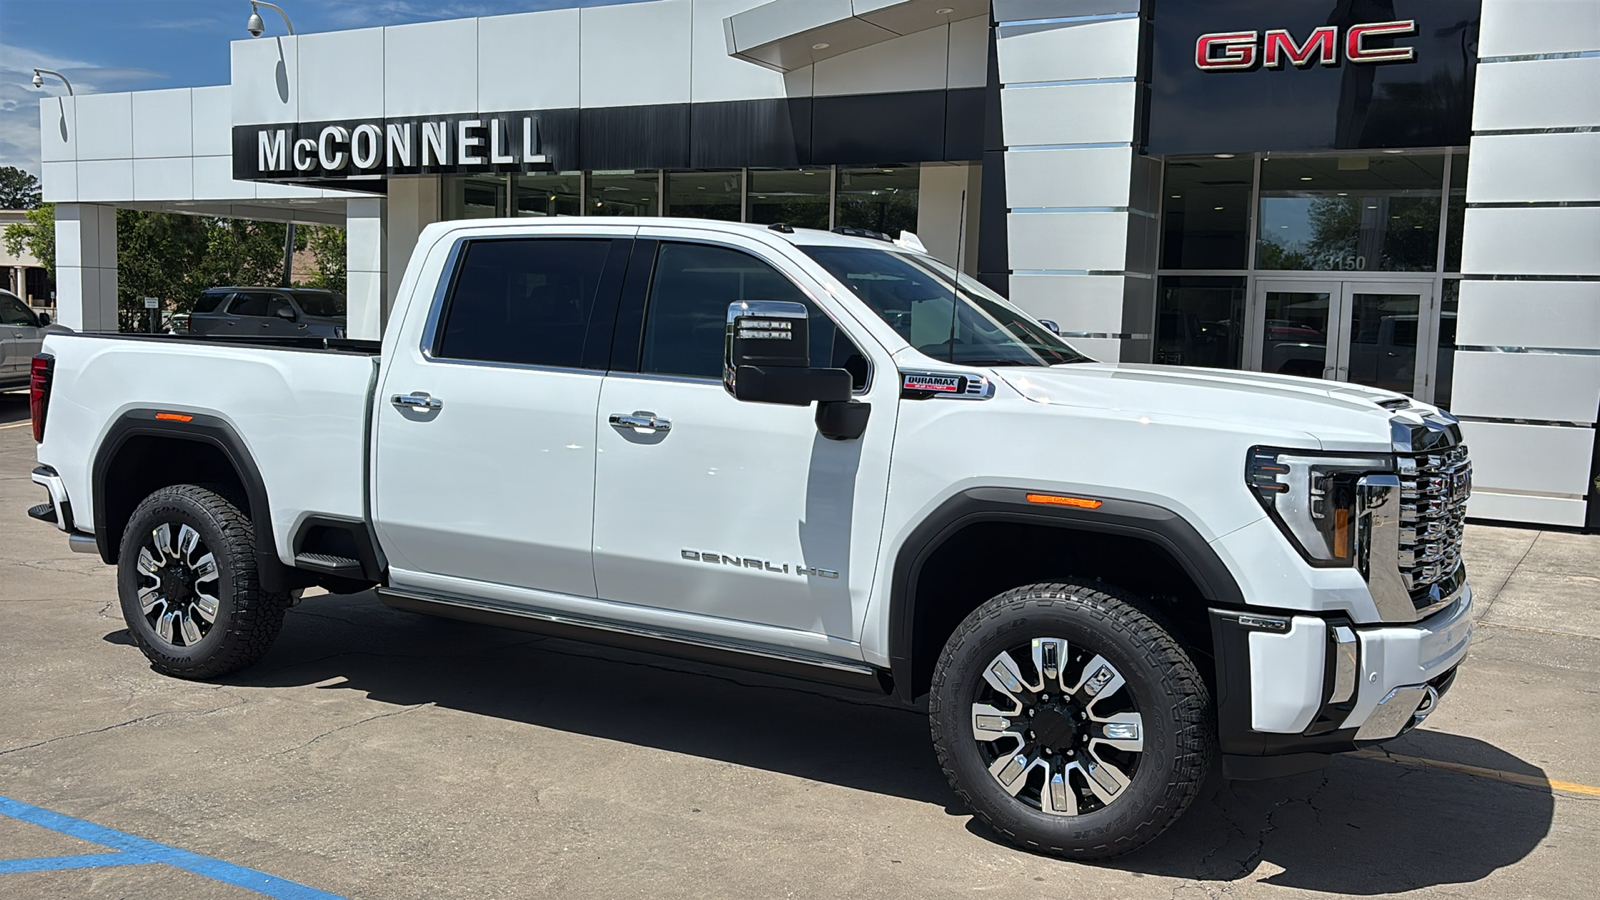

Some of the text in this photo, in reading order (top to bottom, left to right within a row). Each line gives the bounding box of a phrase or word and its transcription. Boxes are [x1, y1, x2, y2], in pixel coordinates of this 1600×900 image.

[1195, 20, 1414, 69] GMC
[257, 117, 547, 171] McCONNELL
[1325, 255, 1366, 271] 3150
[908, 376, 955, 386] DURAMAX
[681, 549, 839, 579] DENALI HD
